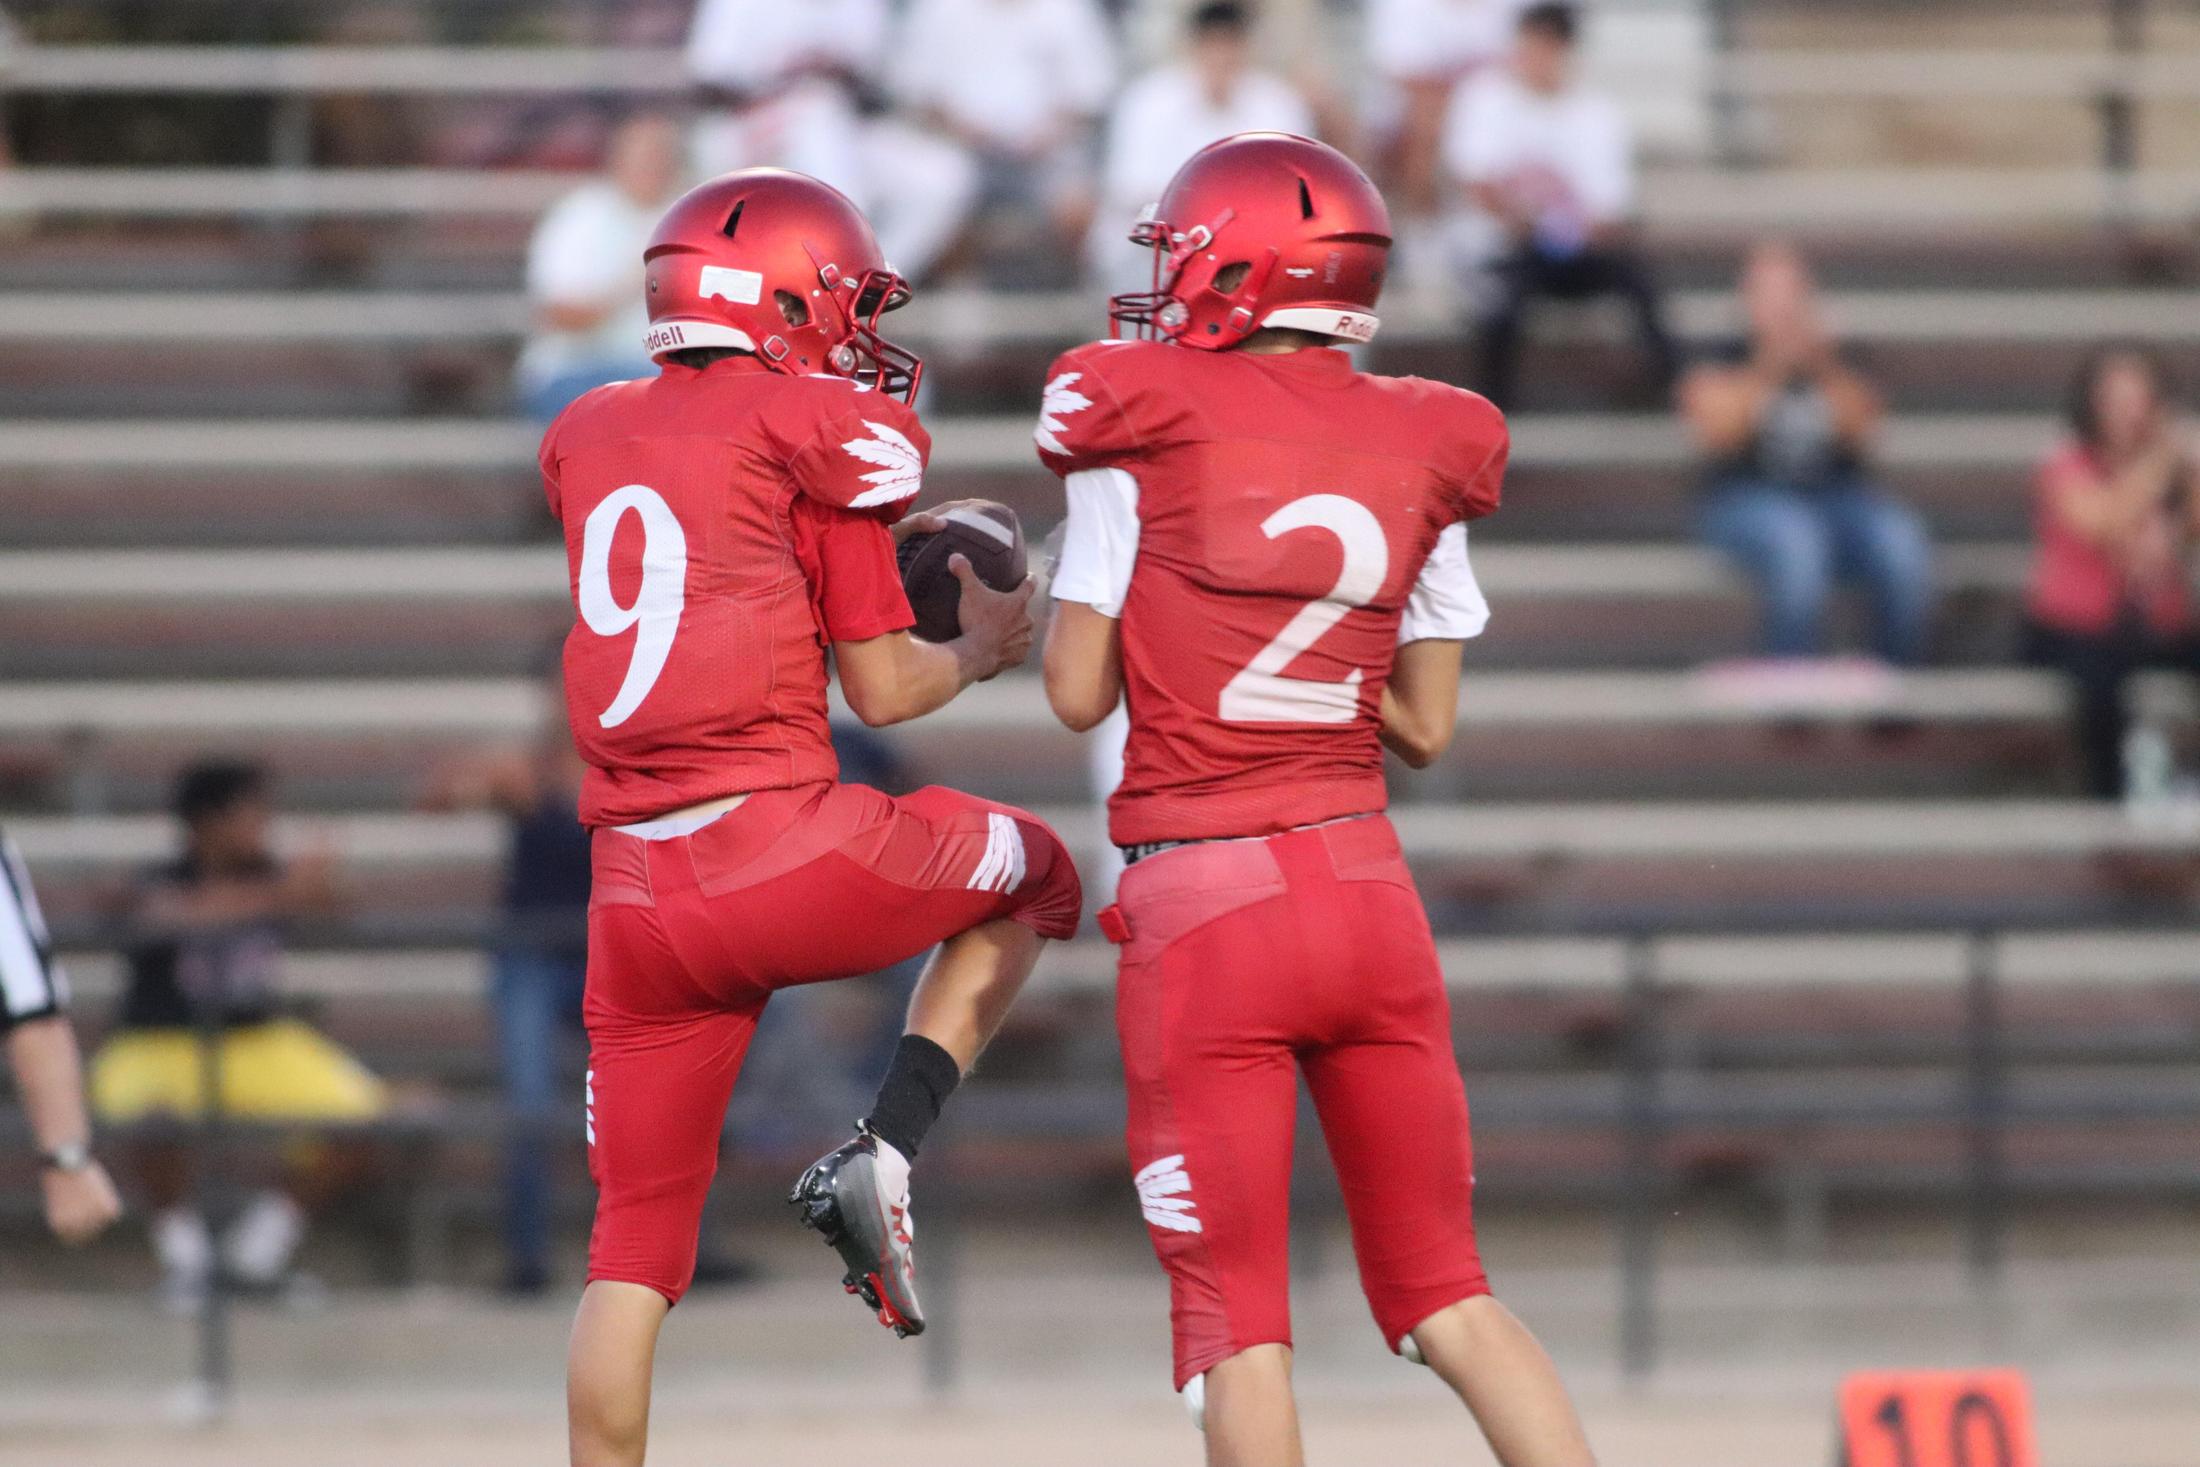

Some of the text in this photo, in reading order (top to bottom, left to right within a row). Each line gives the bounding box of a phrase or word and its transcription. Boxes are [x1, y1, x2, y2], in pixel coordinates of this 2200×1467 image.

[579, 484, 687, 729] 9
[1218, 493, 1389, 724] 2
[1874, 1390, 2014, 1467] 10
